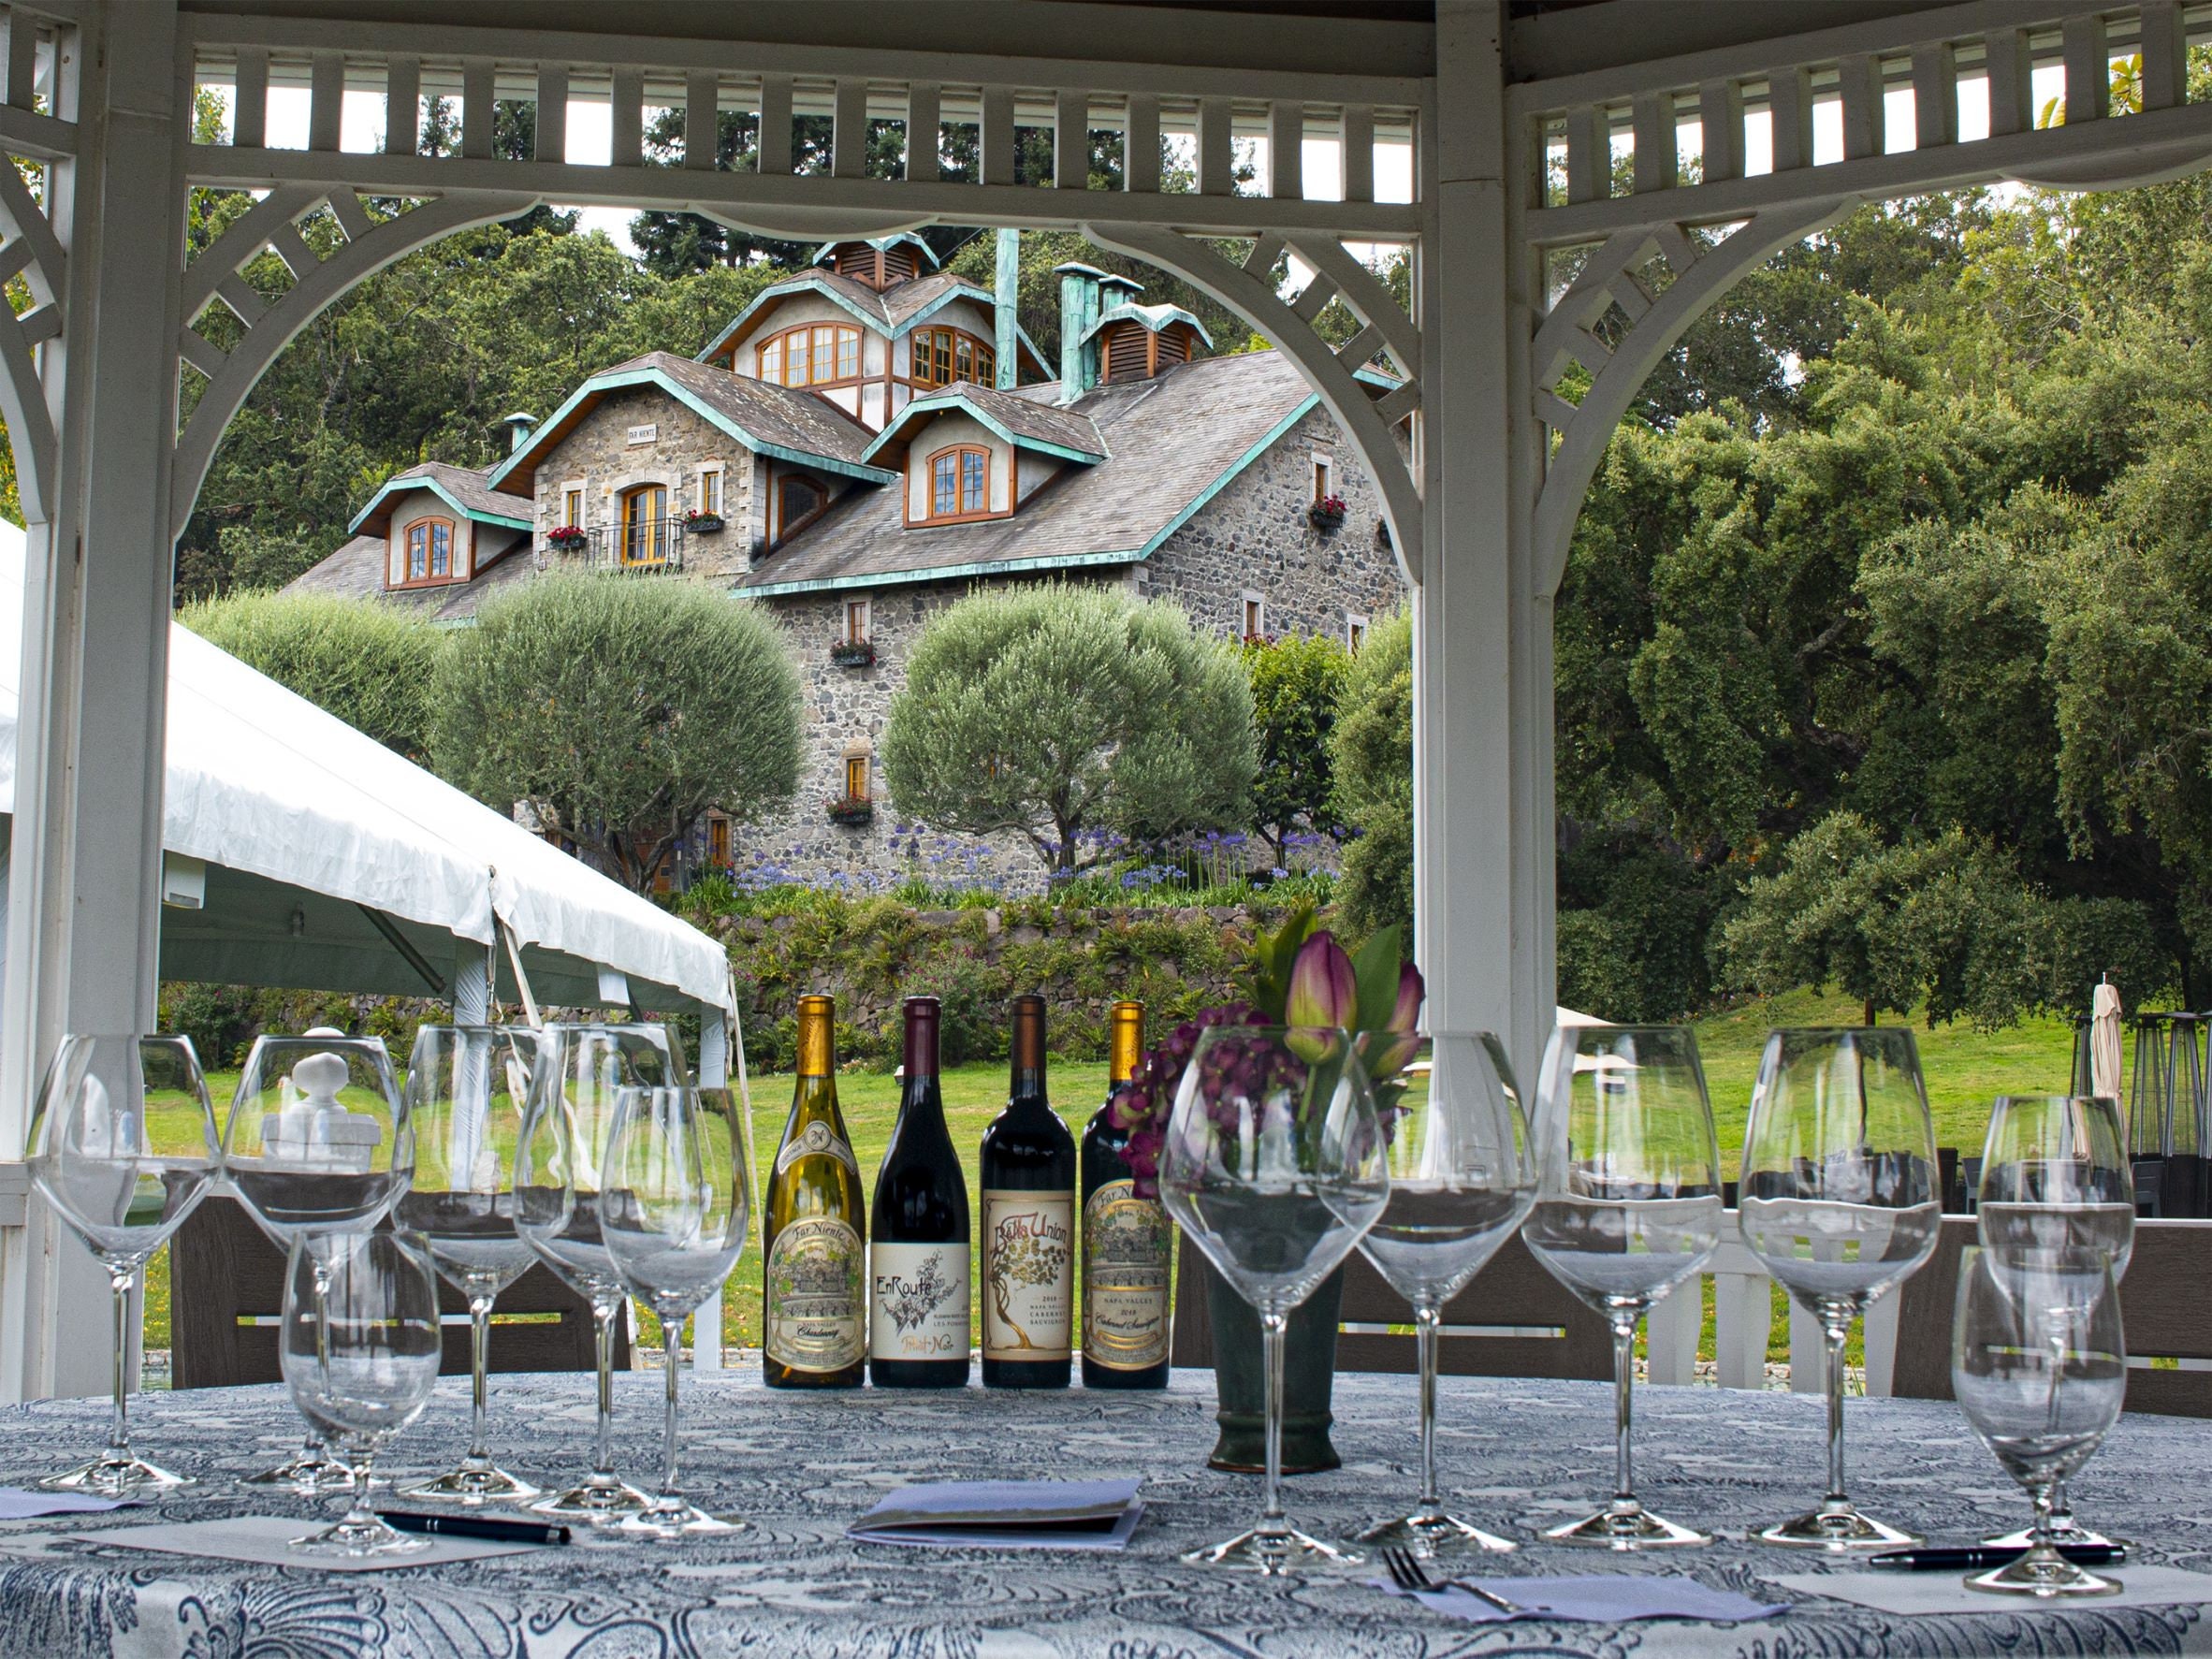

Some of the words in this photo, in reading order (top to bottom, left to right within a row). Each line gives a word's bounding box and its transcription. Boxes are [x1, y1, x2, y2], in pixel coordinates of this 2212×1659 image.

[793, 1226, 809, 1241] Far
[812, 1221, 847, 1242] Niente
[1031, 1211, 1067, 1244] Union
[876, 1275, 932, 1299] EnRoute
[930, 1333, 954, 1354] Noir
